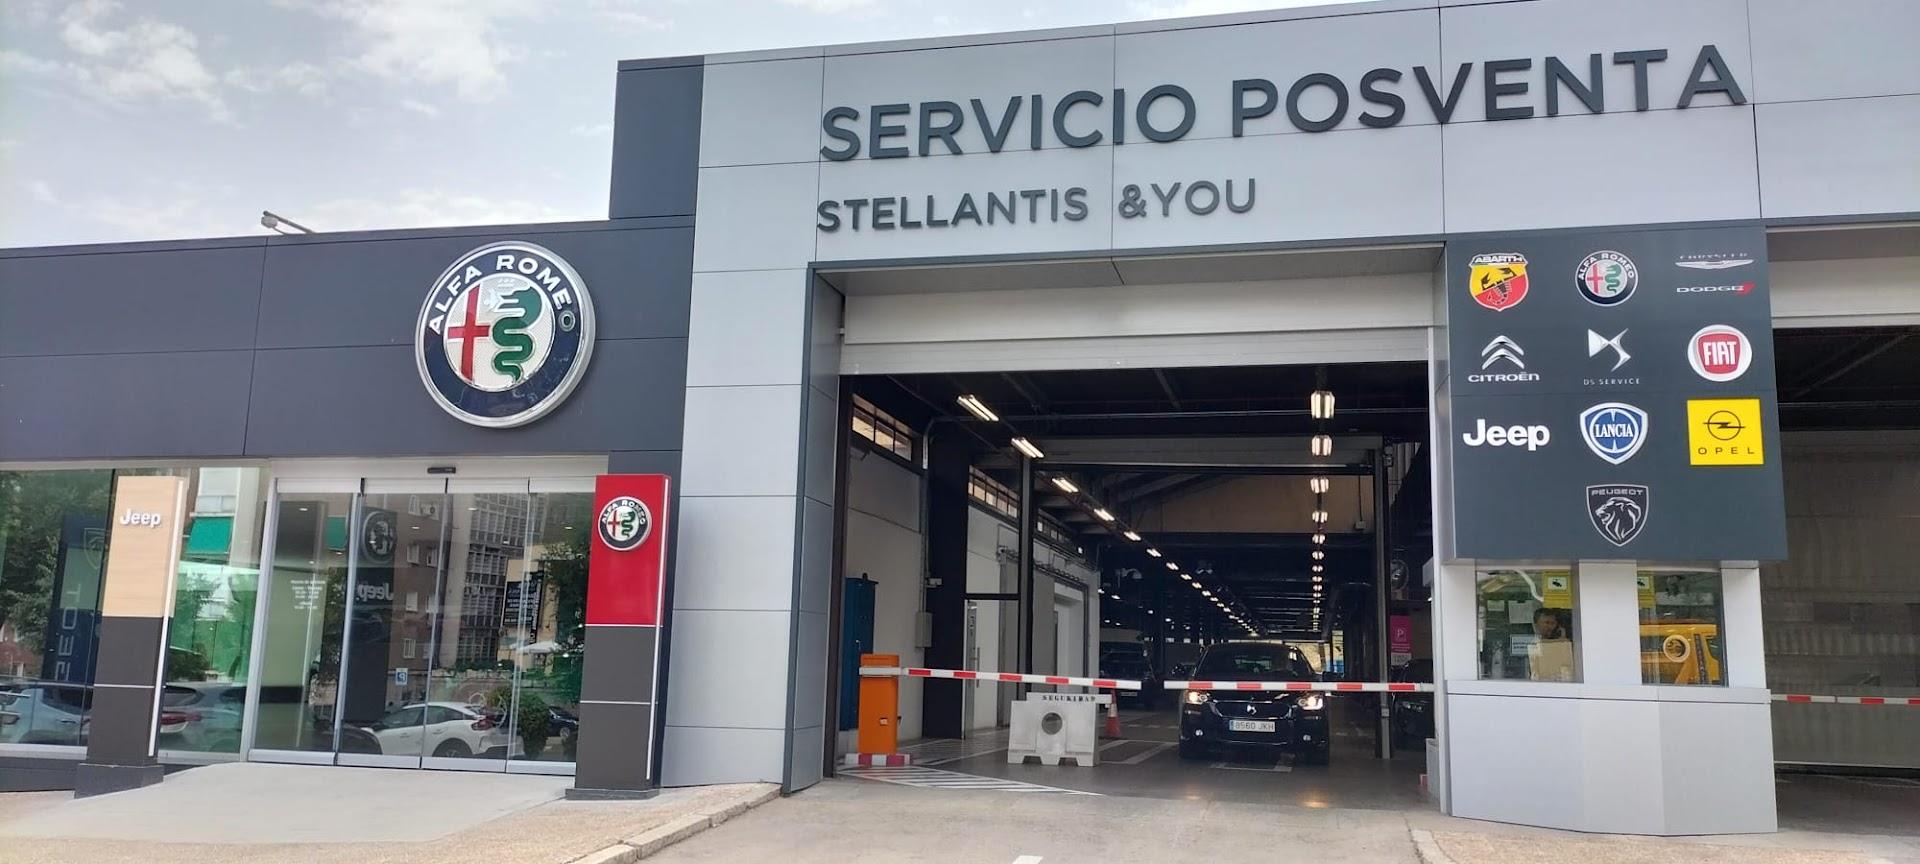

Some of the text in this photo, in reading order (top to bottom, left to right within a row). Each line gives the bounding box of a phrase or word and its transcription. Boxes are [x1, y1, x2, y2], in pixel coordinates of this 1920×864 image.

[820, 44, 1748, 162] SERVICIO POSVENTA
[817, 177, 1257, 233] STELLANTIS &YOU
[1474, 254, 1524, 264] ABARTH
[1578, 252, 1635, 280] ALFA ROMEO
[428, 254, 577, 335] ALFA ROMEO
[1676, 285, 1745, 293] DODGE
[1702, 341, 1737, 366] FIAT
[1468, 371, 1540, 383] CITROËN
[1583, 377, 1641, 386] DS SERVICE
[1462, 418, 1551, 451] Jeep
[1594, 423, 1634, 438] LANCIA
[1697, 446, 1755, 455] OPEL
[1590, 487, 1644, 496] PEUGEOT
[120, 507, 162, 529] Jeep
